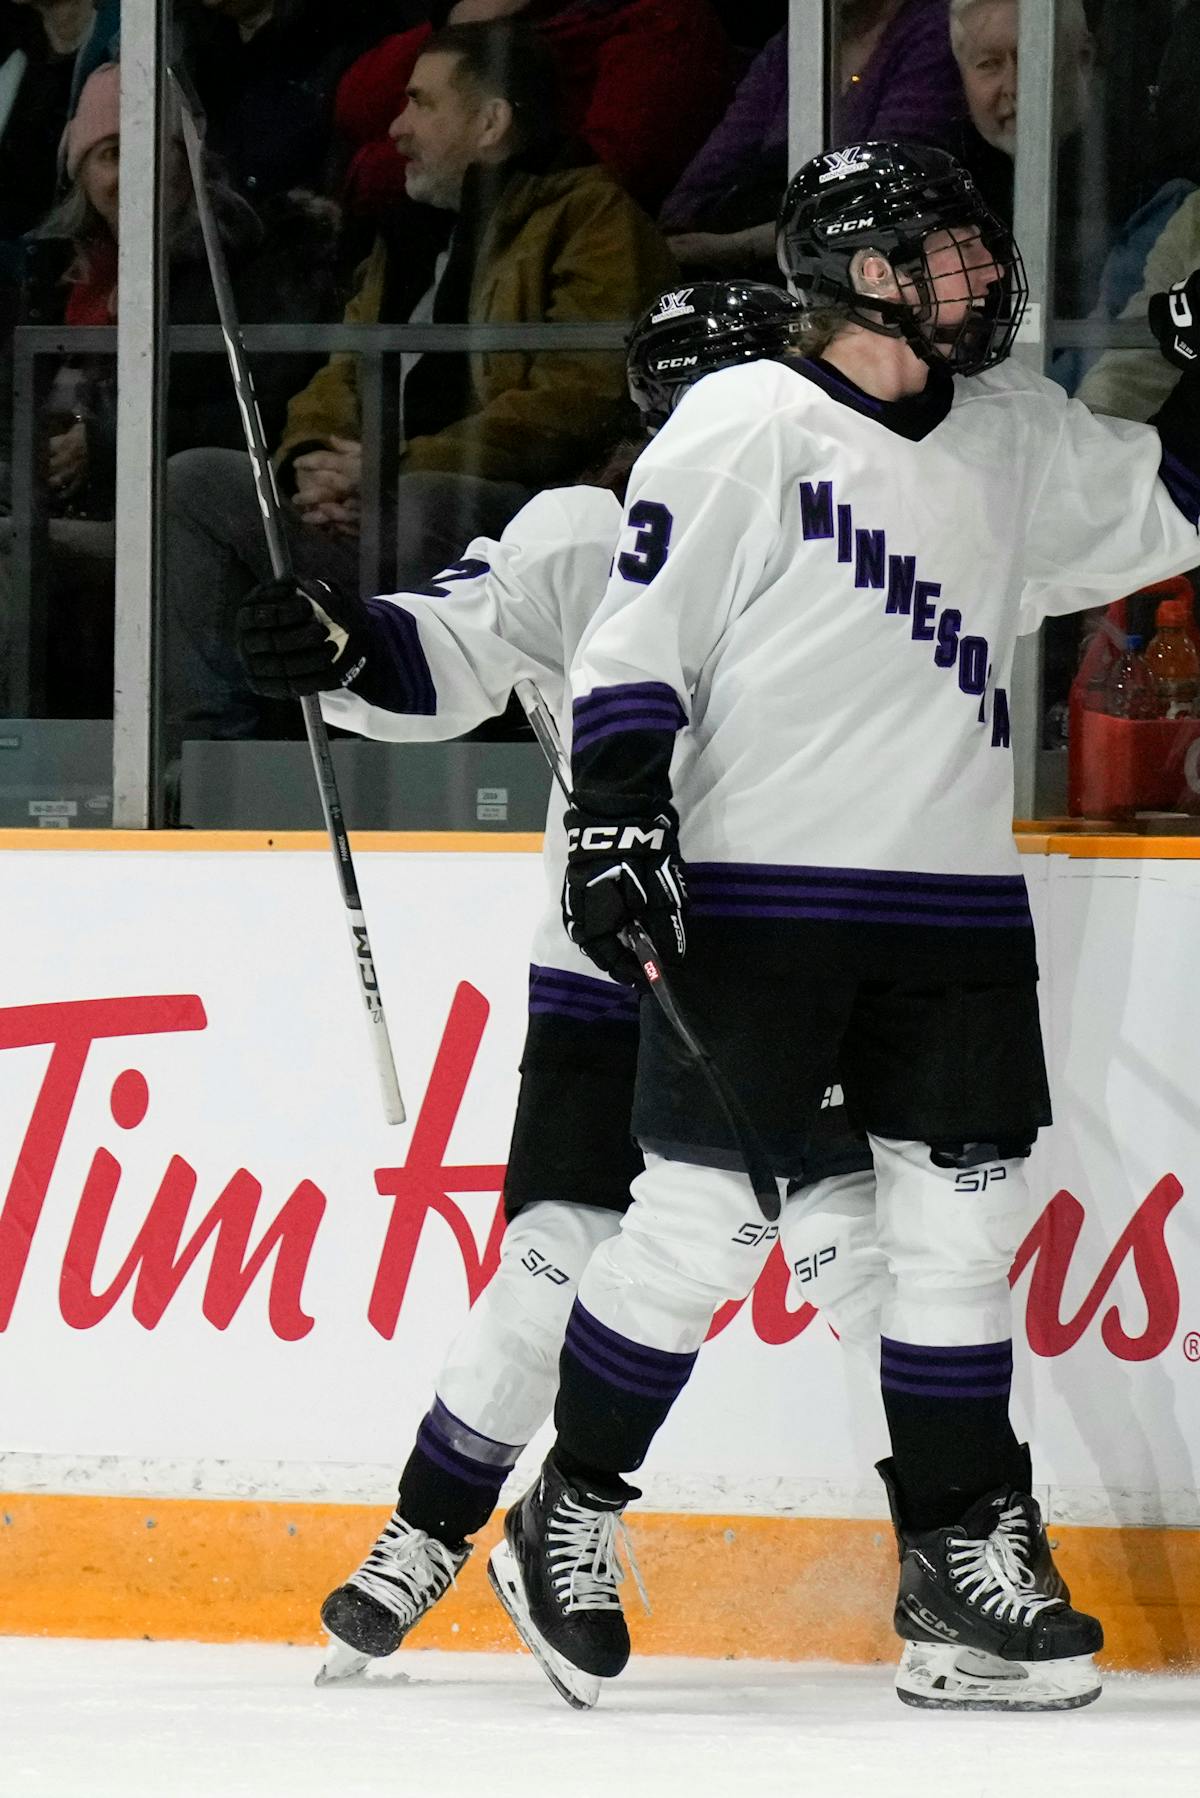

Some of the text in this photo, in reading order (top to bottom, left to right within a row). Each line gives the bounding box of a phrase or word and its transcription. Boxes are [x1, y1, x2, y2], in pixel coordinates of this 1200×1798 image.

[826, 216, 875, 235] CCM
[656, 355, 698, 371] CCM
[799, 480, 1010, 749] MINNESOA
[567, 826, 666, 853] CCM
[669, 914, 686, 954] CCM
[643, 960, 660, 982] CCM
[0, 993, 328, 1342] Tim
[953, 1165, 1007, 1193] SP
[731, 1222, 780, 1248] SP
[520, 1247, 571, 1286] SP
[793, 1245, 837, 1284] SP
[904, 1593, 960, 1640] CCM
